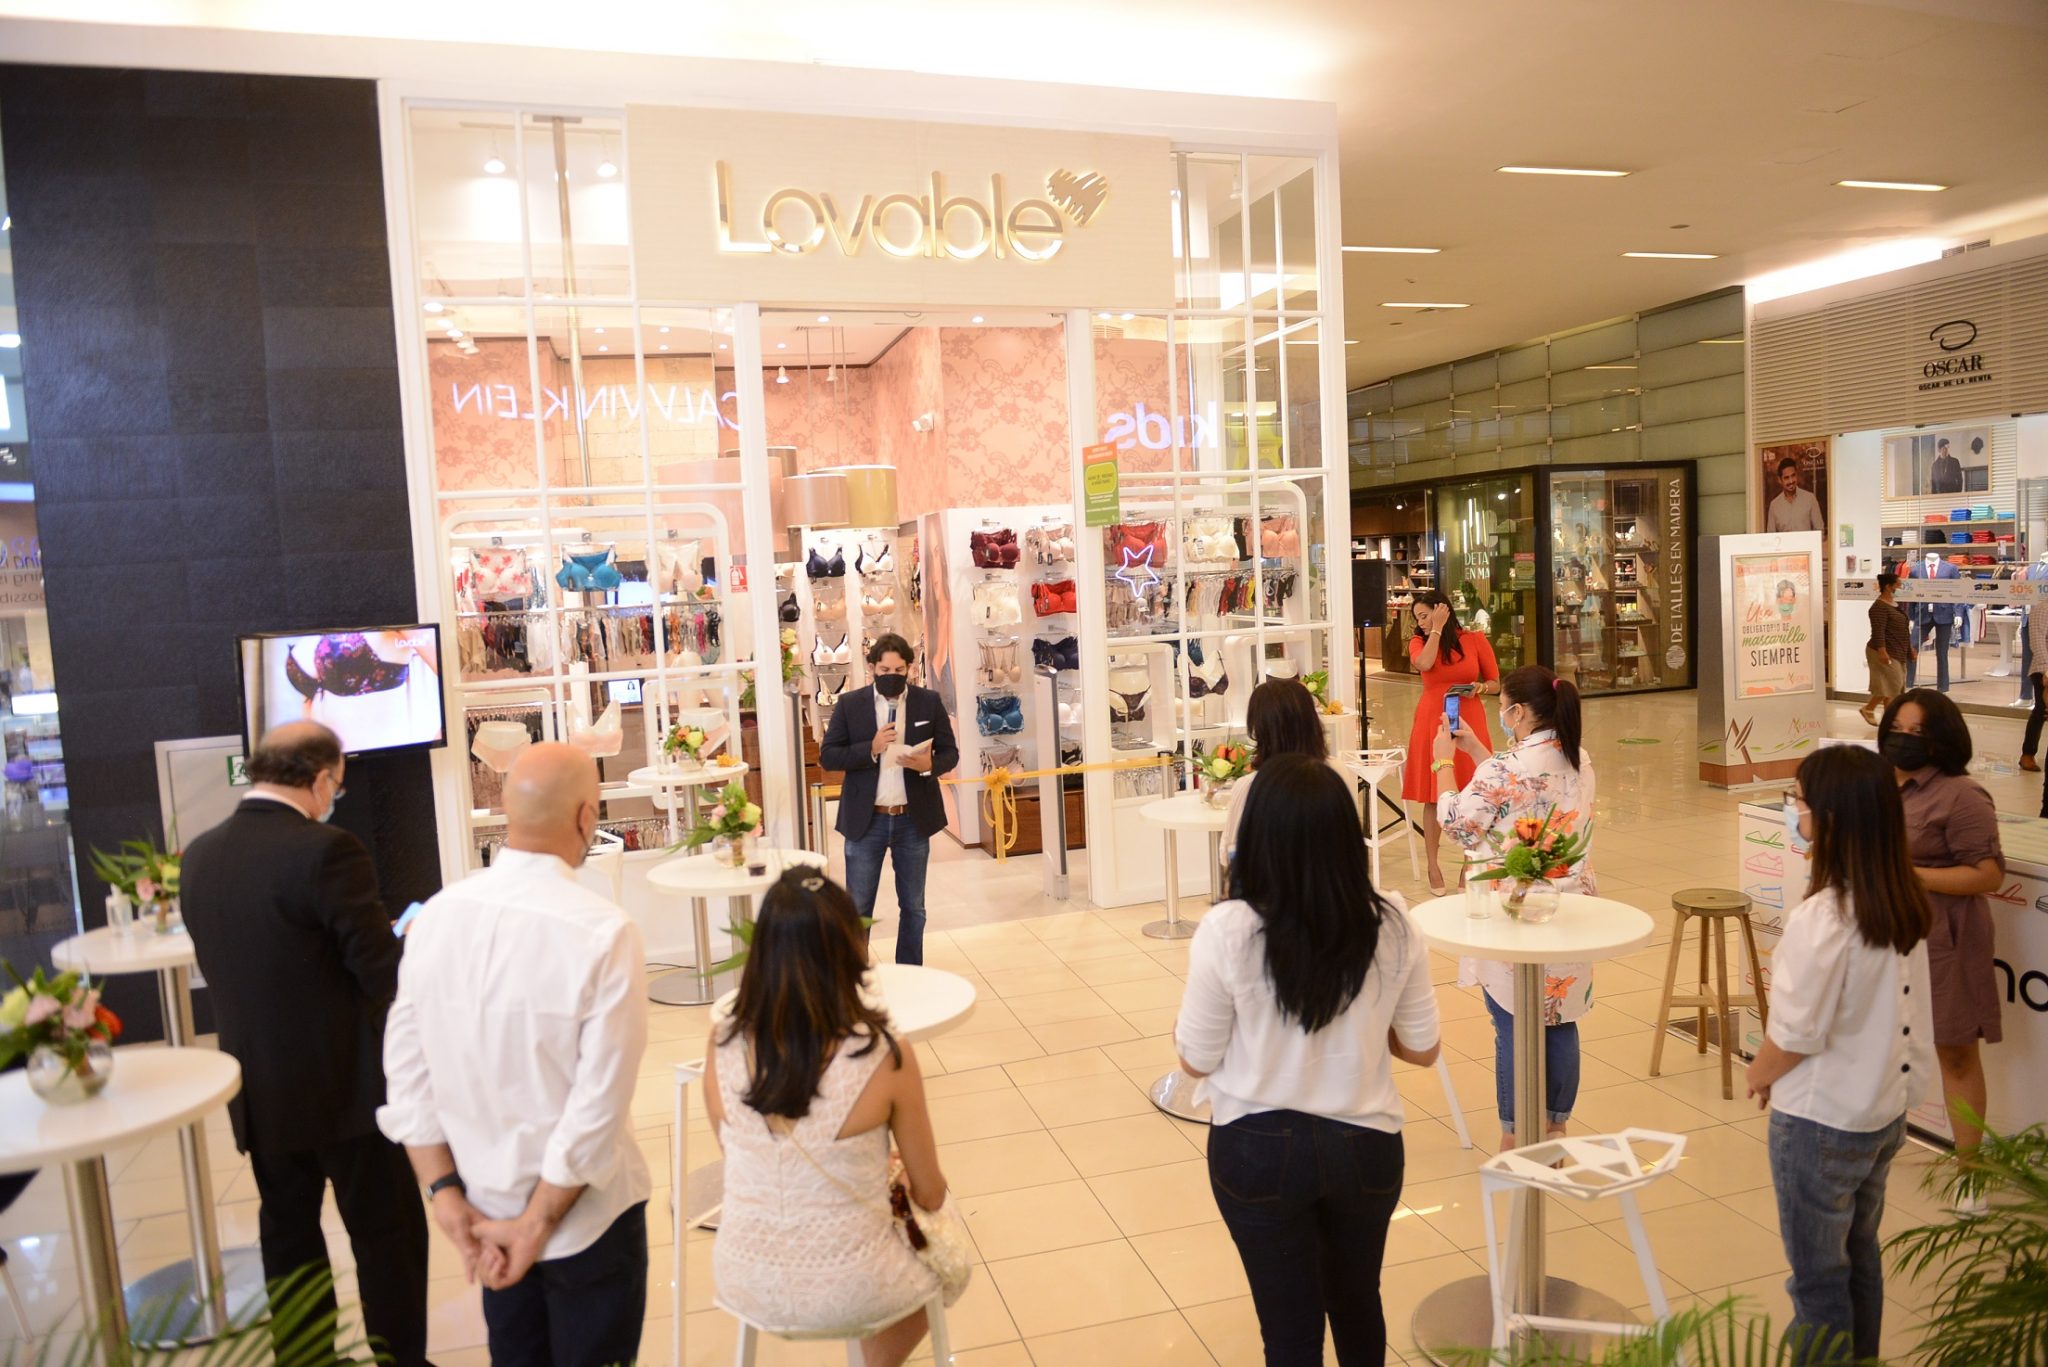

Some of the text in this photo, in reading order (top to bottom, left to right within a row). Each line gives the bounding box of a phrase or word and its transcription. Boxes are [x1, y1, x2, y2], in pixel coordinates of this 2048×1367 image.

[715, 159, 1064, 261] Lovable
[1923, 355, 1983, 378] OSCAR
[1918, 382, 1940, 391] OSCAR
[1968, 374, 1992, 383] RENTA
[1669, 478, 1683, 643] DETALLES EN MADERA
[1465, 568, 1477, 580] EN
[2009, 584, 2033, 594] 30%
[1742, 624, 1780, 634] OBLIGATORIO
[1742, 625, 1807, 647] mascarilla
[1751, 646, 1801, 667] SIEMPRE
